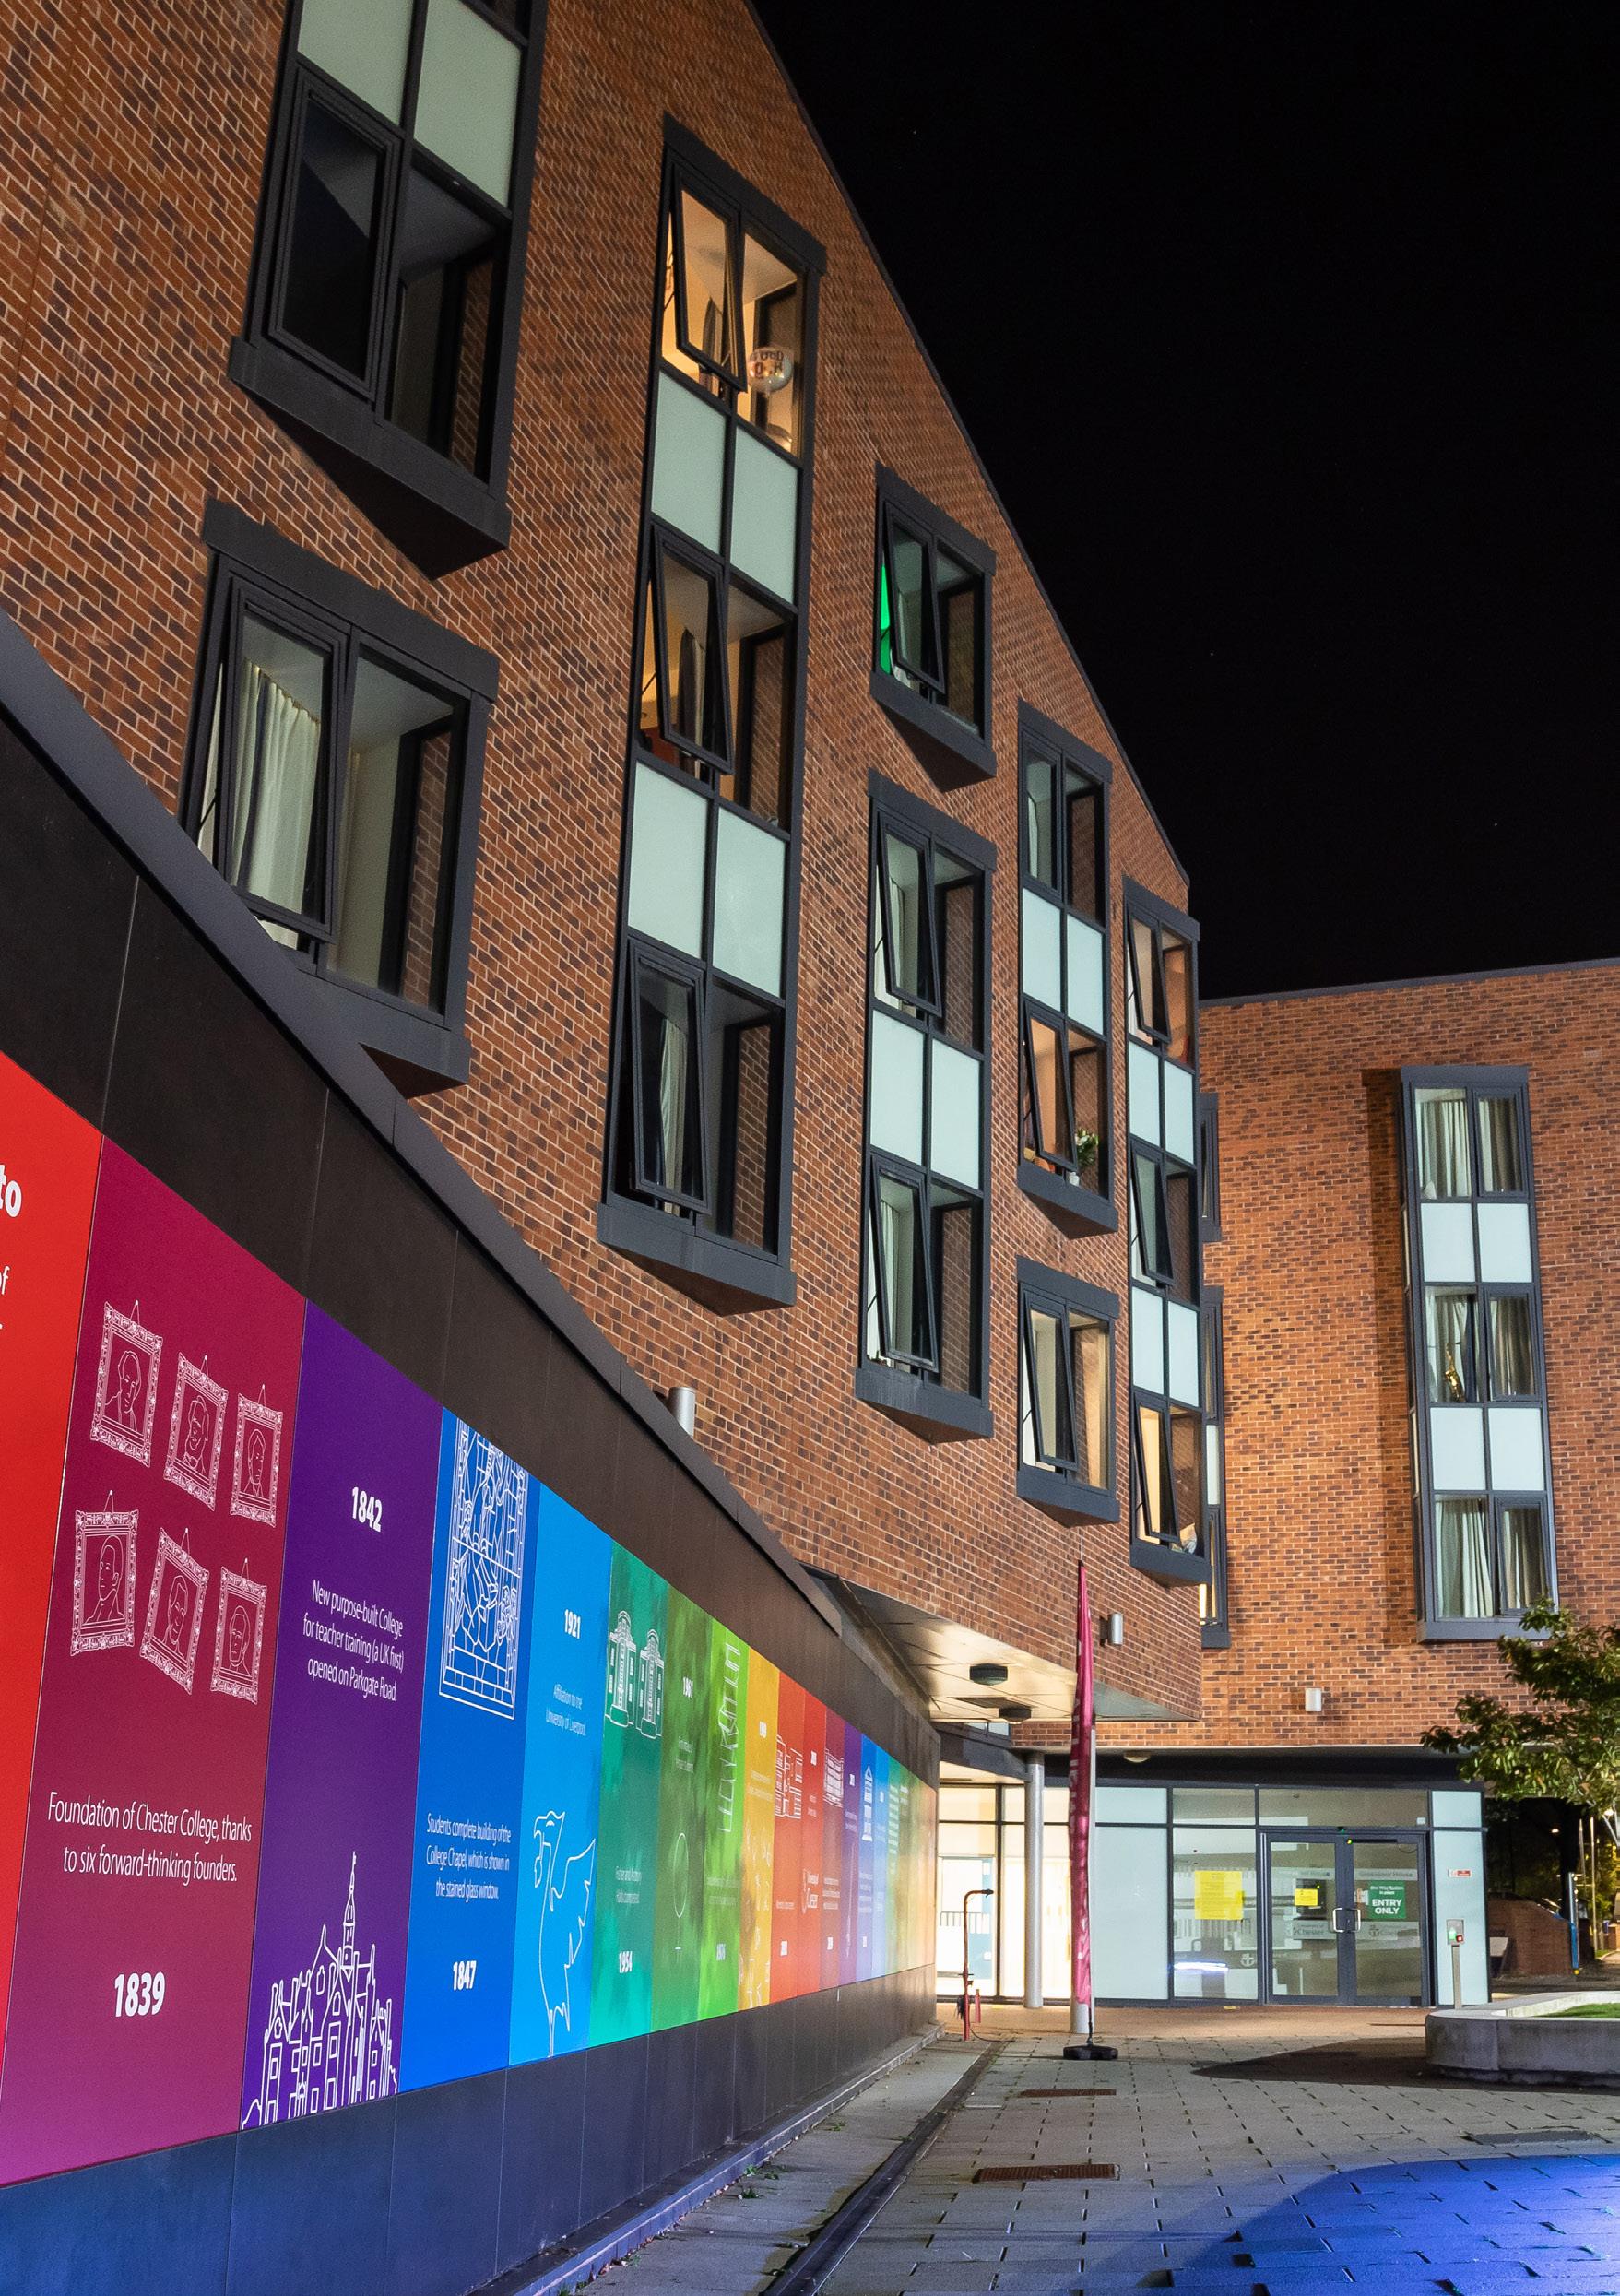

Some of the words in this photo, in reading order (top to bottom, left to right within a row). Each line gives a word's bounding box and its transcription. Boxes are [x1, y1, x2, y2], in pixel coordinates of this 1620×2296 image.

[351, 1486, 383, 1533] 1842
[312, 1579, 331, 1606] New
[331, 1593, 379, 1627] purpose-built
[379, 1608, 404, 1640] College
[564, 1609, 581, 1639] 1921
[303, 1612, 315, 1638] for
[315, 1621, 345, 1648] teacher
[345, 1632, 372, 1664] training
[372, 1639, 379, 1663] (a
[379, 1642, 390, 1665] UK
[390, 1645, 404, 1674] first)
[307, 1658, 338, 1682] opened
[338, 1668, 349, 1686] on
[349, 1666, 379, 1698] Parkgate
[379, 1677, 397, 1702] Road.
[48, 1791, 120, 1828] Foundation
[122, 1801, 137, 1829] of
[136, 1803, 179, 1834] Chester
[180, 1808, 219, 1845] College,
[221, 1814, 252, 1842] thanks
[427, 1812, 452, 1836] Students
[452, 1818, 477, 1841] complete
[477, 1820, 497, 1846] building
[63, 1846, 77, 1873] to
[79, 1845, 97, 1874] six
[98, 1843, 192, 1887] forward-thinking
[193, 1852, 237, 1882] founders.
[426, 1844, 448, 1871] College
[467, 1850, 484, 1869] which
[484, 1852, 489, 1870] is
[488, 1852, 504, 1871] shown
[504, 1854, 510, 1871] in
[435, 1876, 446, 1897] the
[446, 1878, 466, 1898] stained
[466, 1878, 479, 1903] glass
[1371, 1899, 1402, 1907] ENTRY
[1374, 1907, 1400, 1915] ONLY
[114, 1971, 166, 2018] 1839
[453, 1959, 477, 1991] 1847
